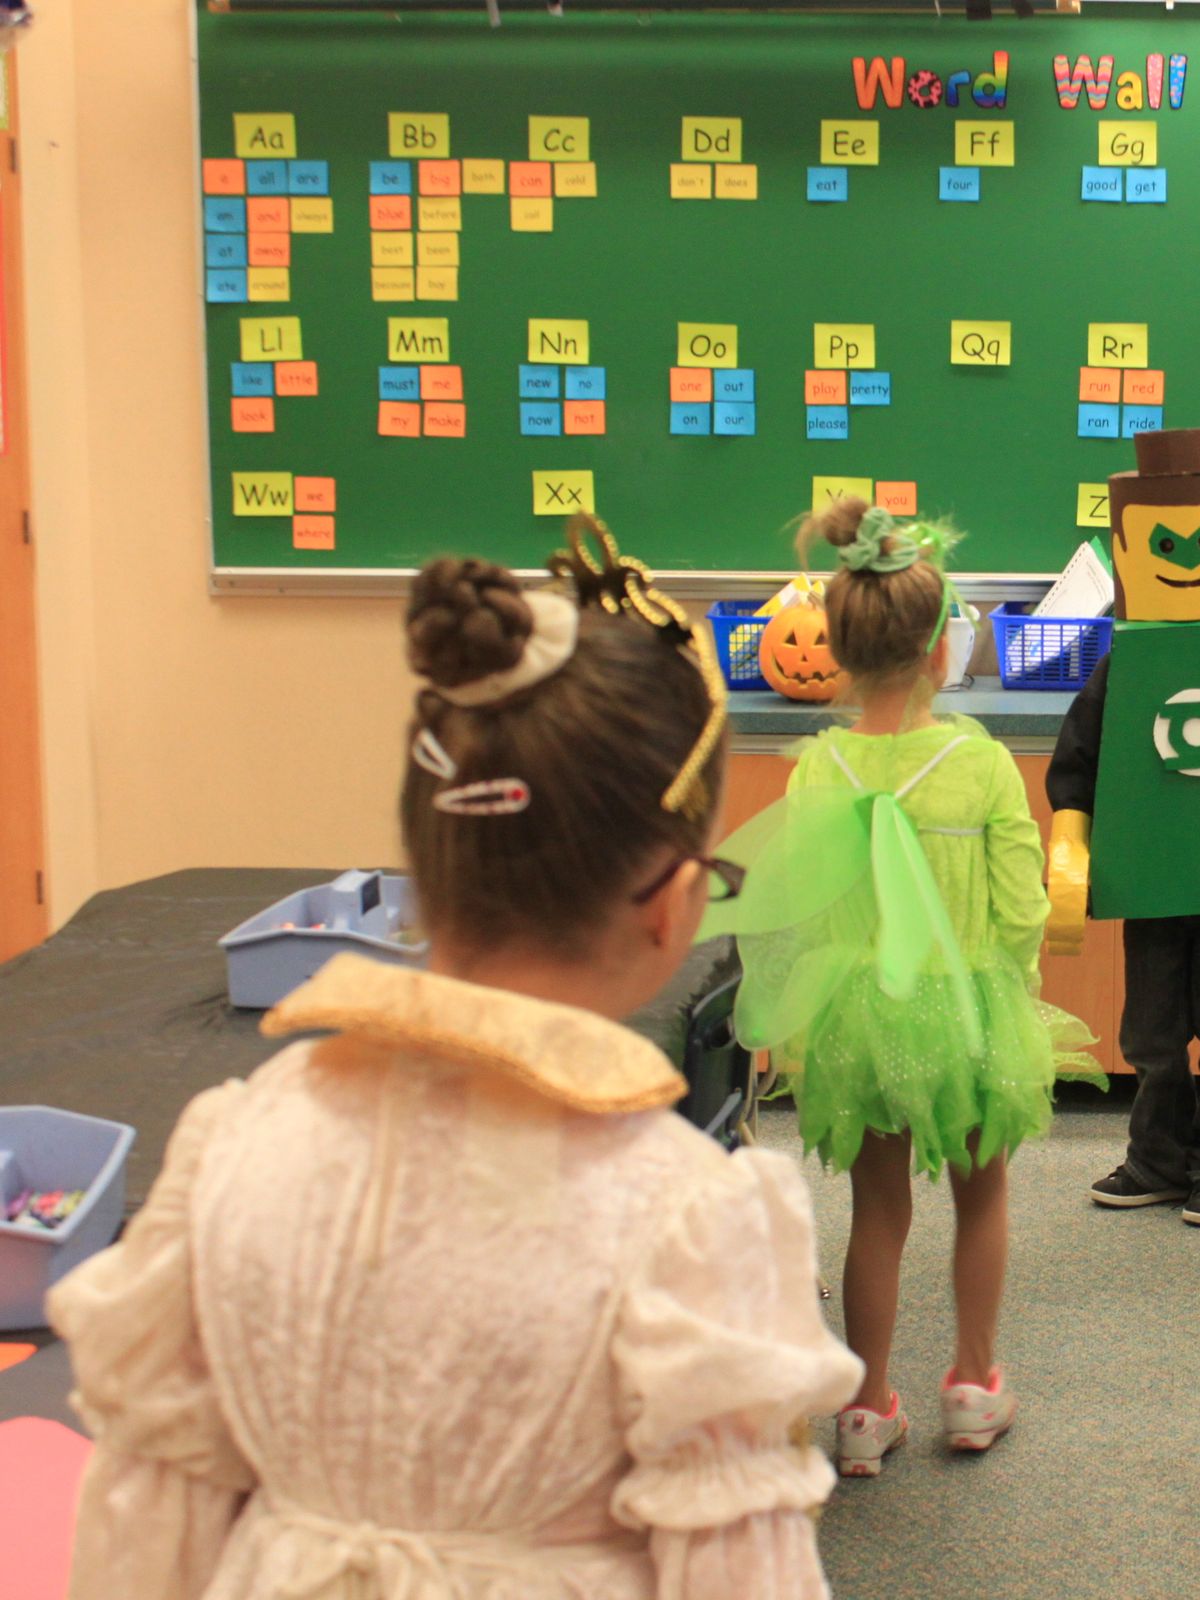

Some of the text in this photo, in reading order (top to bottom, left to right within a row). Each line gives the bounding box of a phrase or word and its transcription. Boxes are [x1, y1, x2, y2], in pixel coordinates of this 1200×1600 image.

[852, 49, 1188, 109] Word Wall
[250, 125, 285, 150] Aa
[403, 123, 437, 150] Bb
[543, 128, 576, 154] Cc
[694, 128, 730, 153] Dd
[833, 130, 866, 156] Ee
[970, 131, 1001, 157] Ff
[1110, 132, 1145, 165] Gg
[296, 174, 320, 184] are
[381, 172, 400, 185] be
[520, 176, 544, 187] can
[816, 179, 839, 191] eat
[946, 178, 973, 190] four
[1086, 179, 1118, 193] good
[1135, 180, 1157, 193] get
[217, 246, 233, 257] at
[396, 330, 443, 354] Mm
[540, 332, 578, 355] Nn
[689, 334, 727, 359] Oo
[961, 332, 1001, 365] Qq
[1102, 336, 1133, 359] Rr
[830, 335, 859, 367] Pp
[242, 373, 264, 386] like
[383, 379, 415, 391] must
[432, 380, 450, 389] me
[526, 379, 551, 389] new
[578, 379, 593, 389] no
[680, 382, 702, 392] one
[724, 381, 745, 392] out
[813, 382, 840, 397] play
[851, 383, 889, 397] pretty
[1089, 382, 1112, 392] run
[1132, 382, 1156, 394] red
[391, 416, 409, 429] my
[428, 415, 462, 427] make
[528, 415, 553, 426] now
[574, 413, 596, 425] not
[683, 415, 698, 425] on
[725, 416, 745, 425] our
[808, 416, 848, 430] please
[1087, 417, 1110, 428] ran
[1129, 416, 1156, 429] ride
[239, 482, 289, 507] Ww
[306, 491, 323, 501] we
[545, 482, 582, 506] Xx
[884, 495, 908, 506] you
[1089, 495, 1108, 519] Z
[297, 528, 331, 538] where
